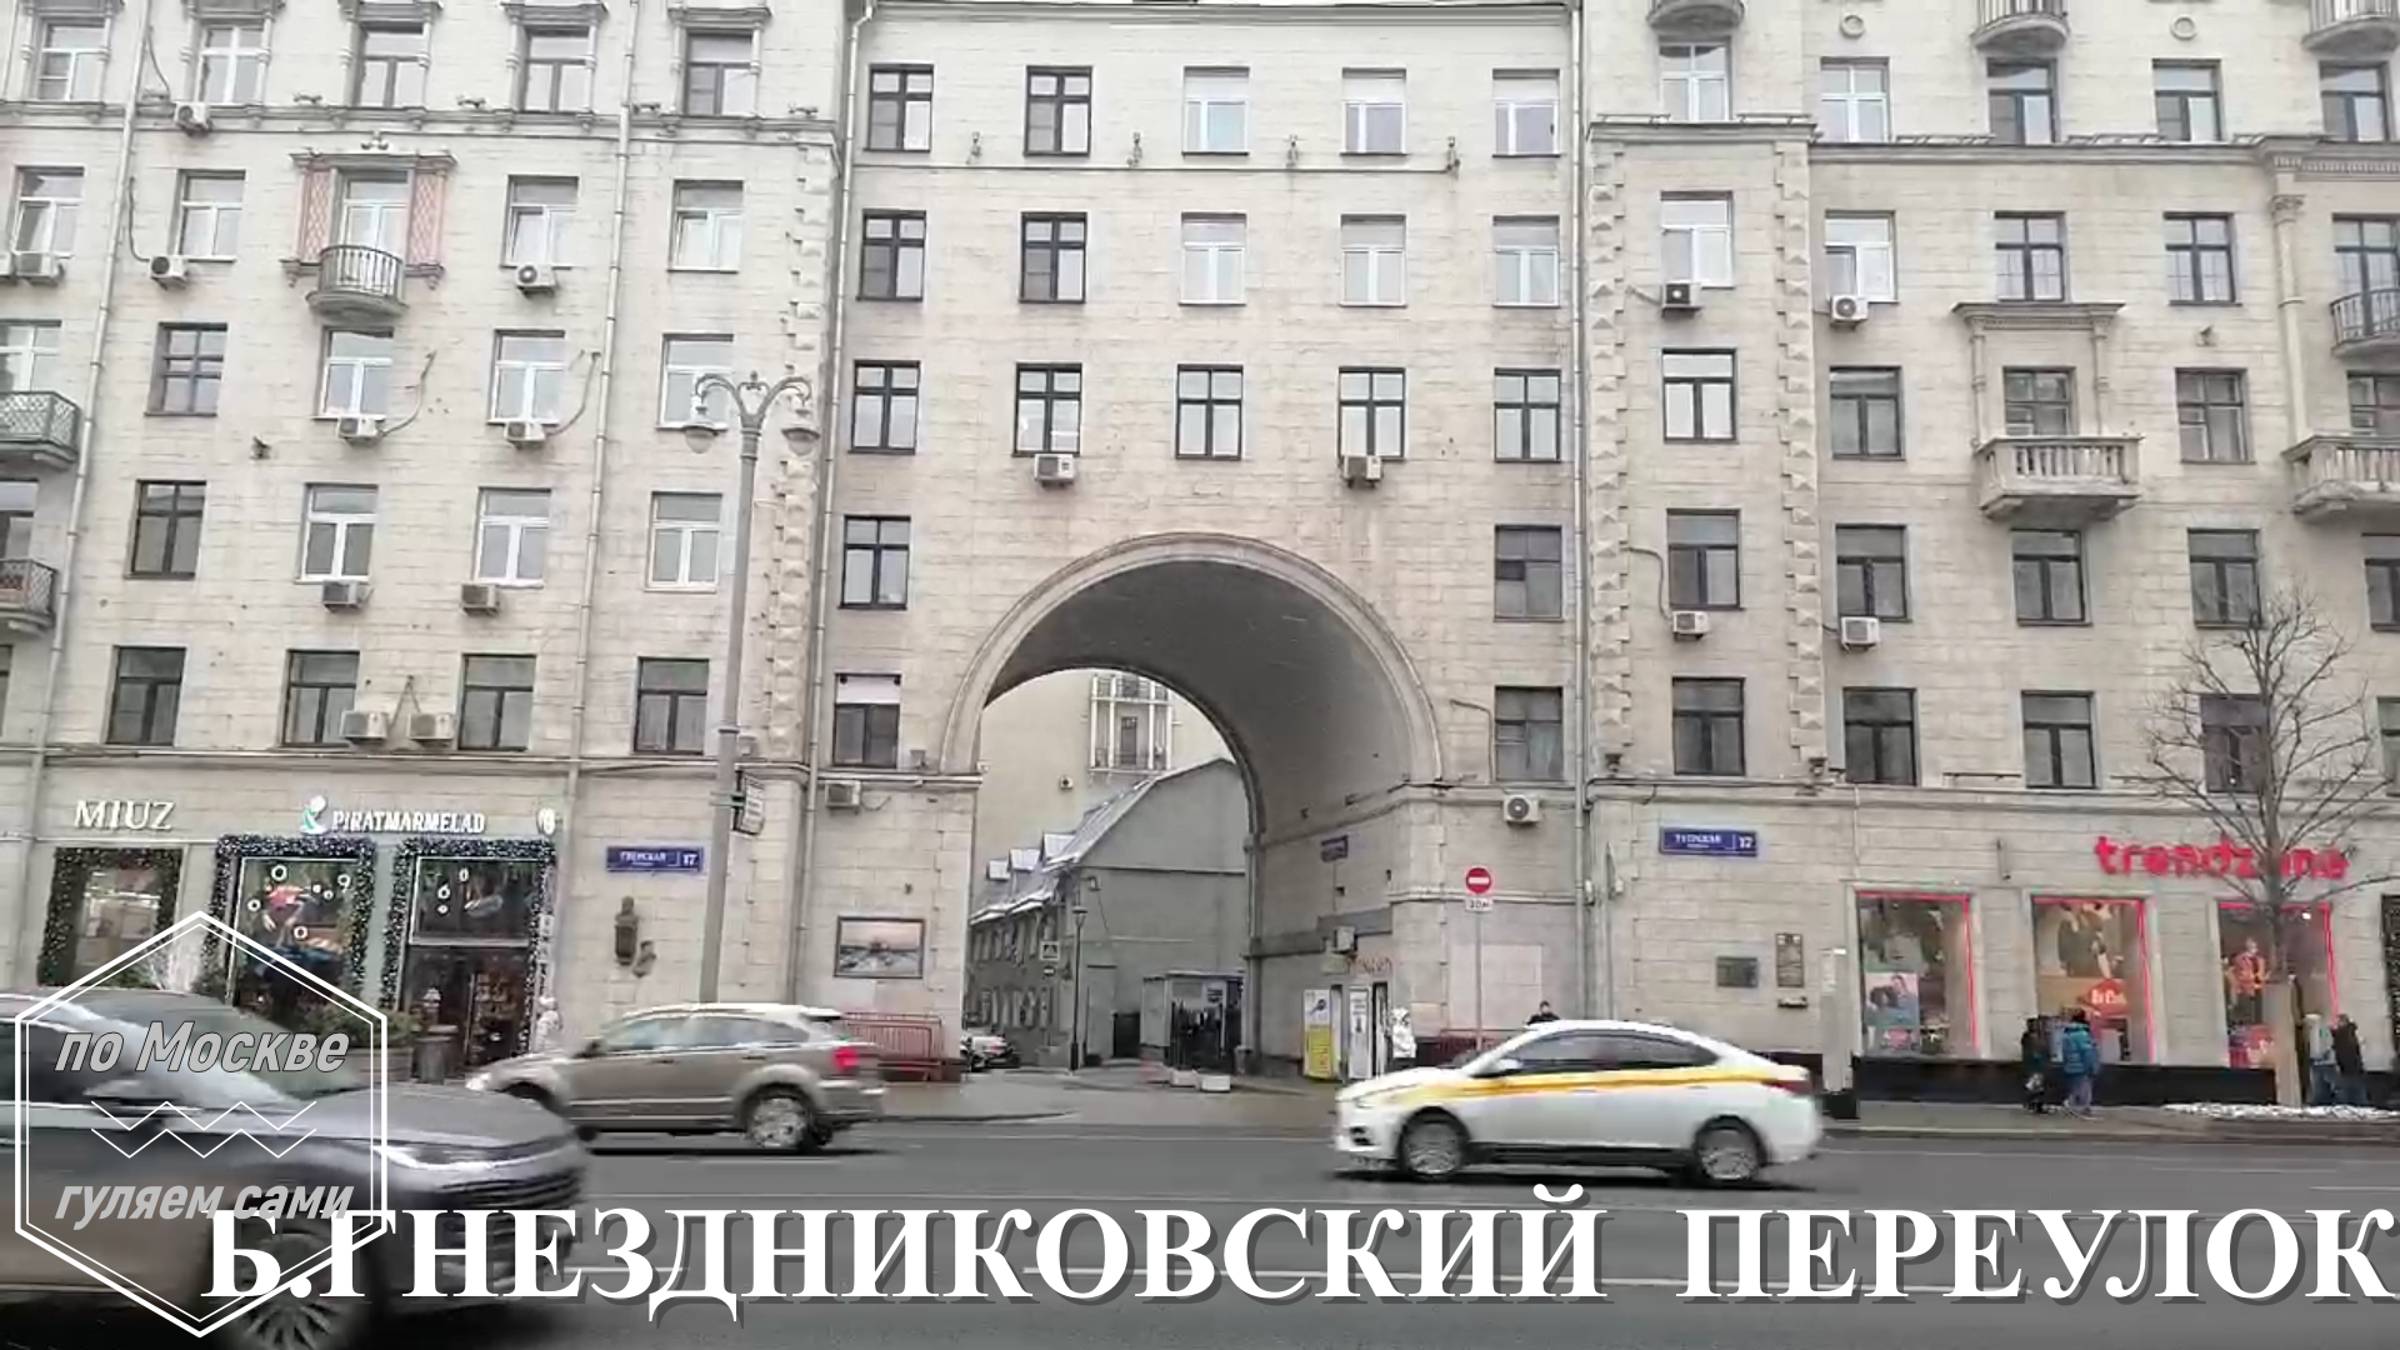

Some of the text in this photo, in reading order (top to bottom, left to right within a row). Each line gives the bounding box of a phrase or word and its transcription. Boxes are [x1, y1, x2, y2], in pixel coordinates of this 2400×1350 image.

[74, 799, 176, 830] MIUZ
[332, 811, 486, 834] PIRATMARMELAD
[2094, 835, 2350, 879] trendzne
